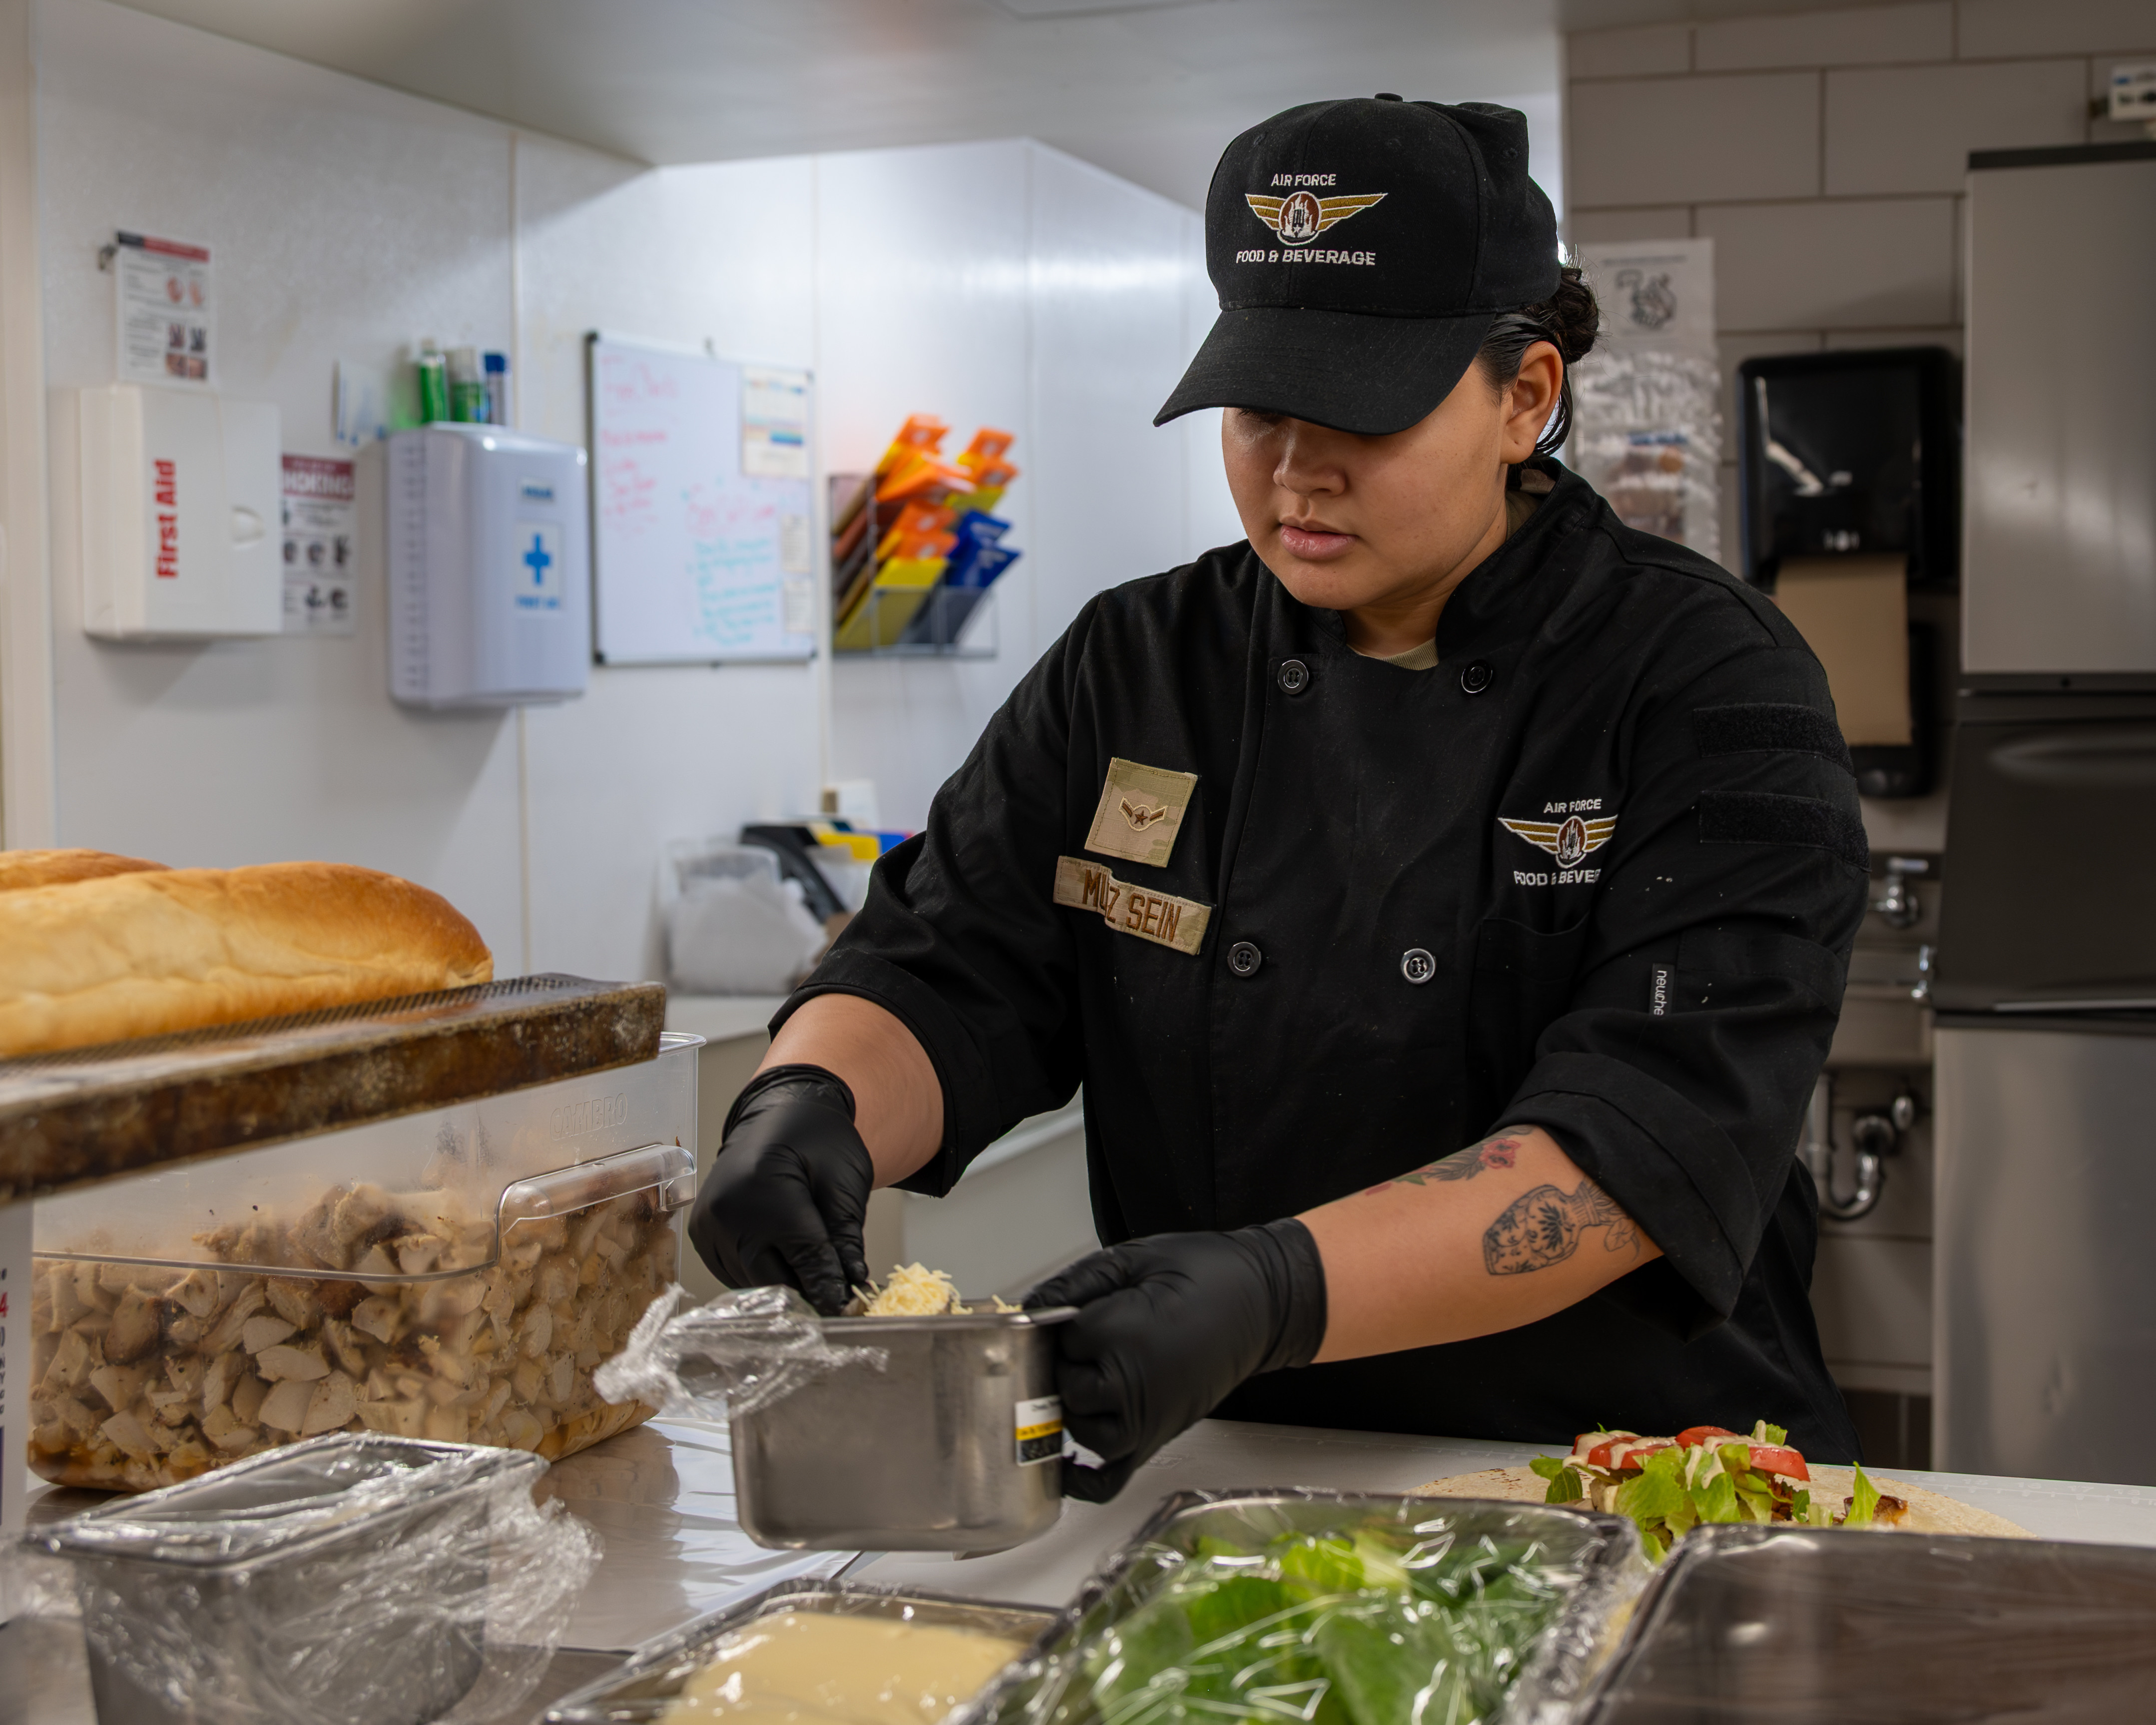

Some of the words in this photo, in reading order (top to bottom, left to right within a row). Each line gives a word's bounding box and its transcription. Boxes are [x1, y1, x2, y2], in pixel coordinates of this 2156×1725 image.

[1271, 173, 1293, 187] AIR
[1294, 173, 1337, 186] FORCE
[1236, 249, 1265, 264] FOOD
[1268, 249, 1279, 263] &
[1282, 249, 1376, 266] BEVERAGE
[154, 459, 175, 506] Aid
[157, 513, 177, 578] First
[1543, 802, 1568, 813] AIR
[1569, 799, 1602, 813] FORCE
[1125, 892, 1182, 943] SEIN
[549, 1093, 628, 1141] CAMBRO
